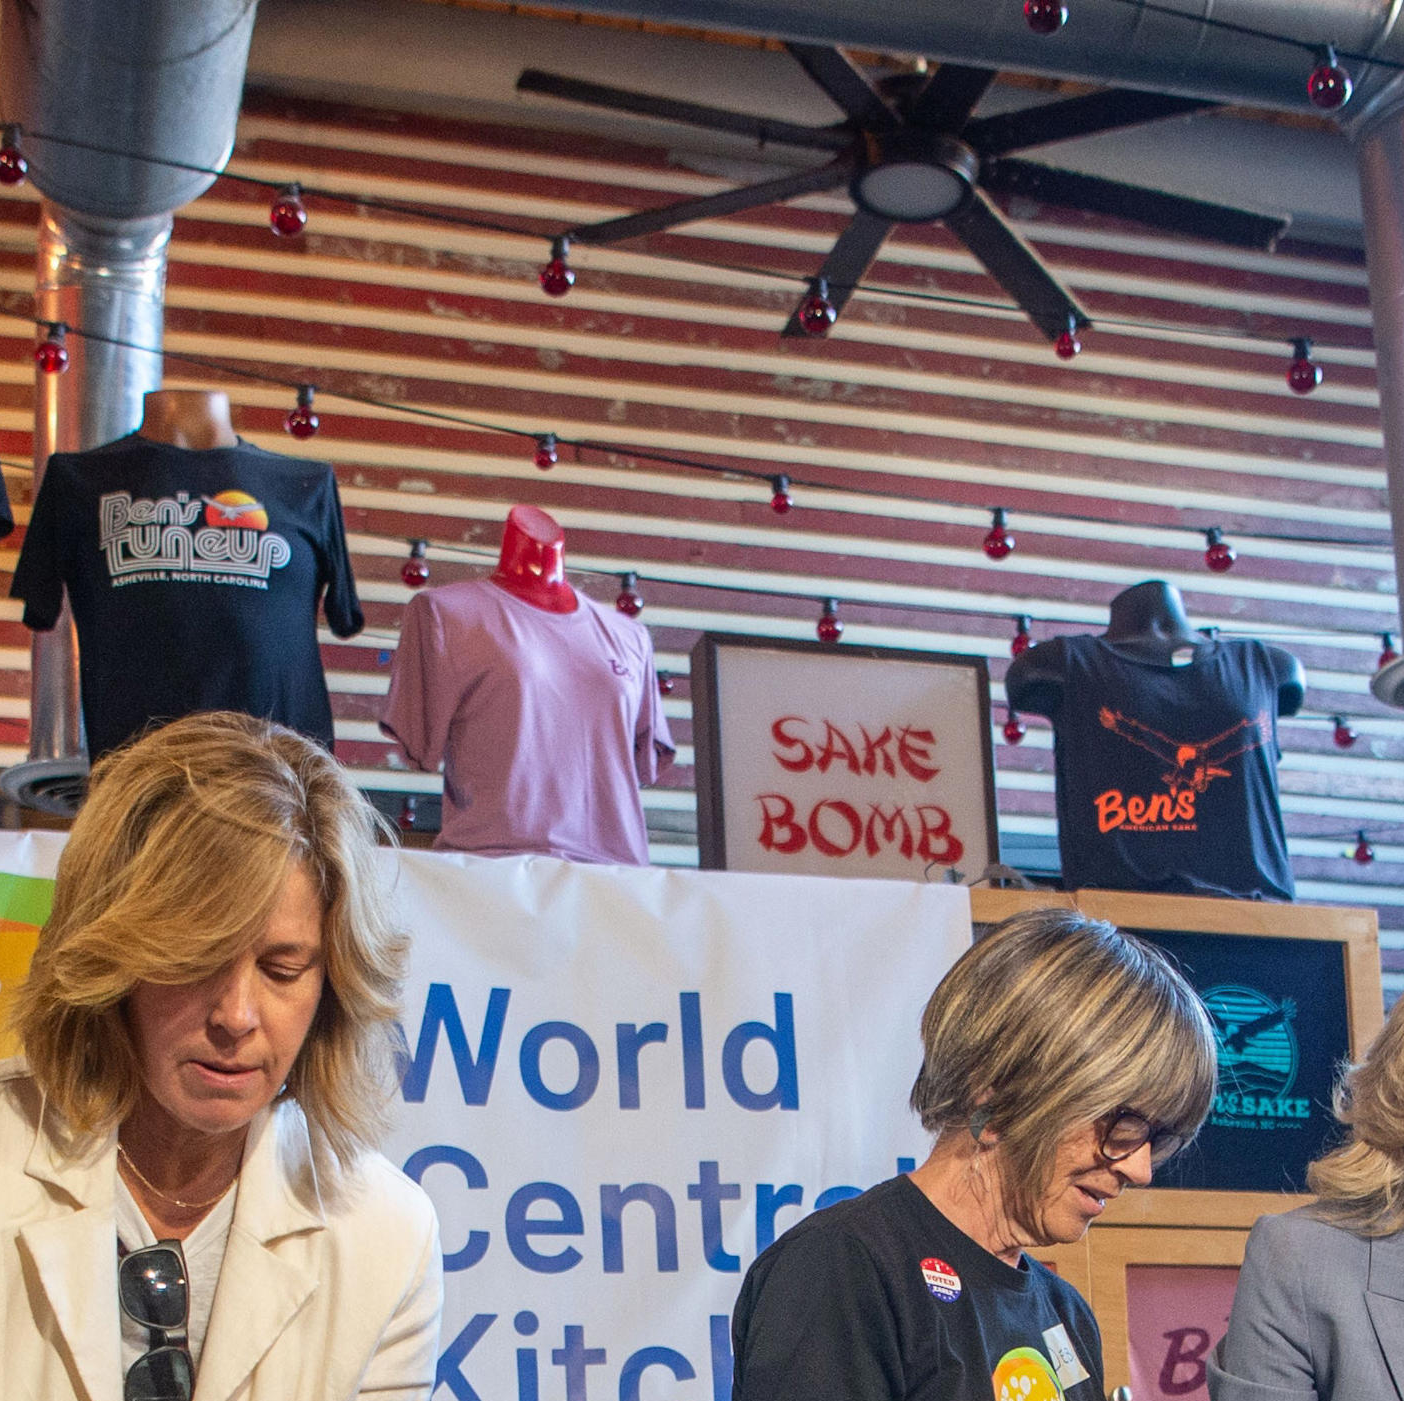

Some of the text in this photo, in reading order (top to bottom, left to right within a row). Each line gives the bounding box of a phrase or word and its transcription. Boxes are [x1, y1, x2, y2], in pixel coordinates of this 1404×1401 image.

[100, 490, 203, 537] Ben's
[112, 572, 269, 591] ASHEVILLE, NORTH CAROLINA
[771, 714, 941, 783] SAKE
[755, 791, 964, 865] BOMB
[1094, 788, 1195, 834] Ben's
[1119, 824, 1169, 832] AMERICAN
[396, 983, 800, 1112] World
[1242, 1096, 1310, 1118] SAKE
[926, 1274, 955, 1287] VOTED
